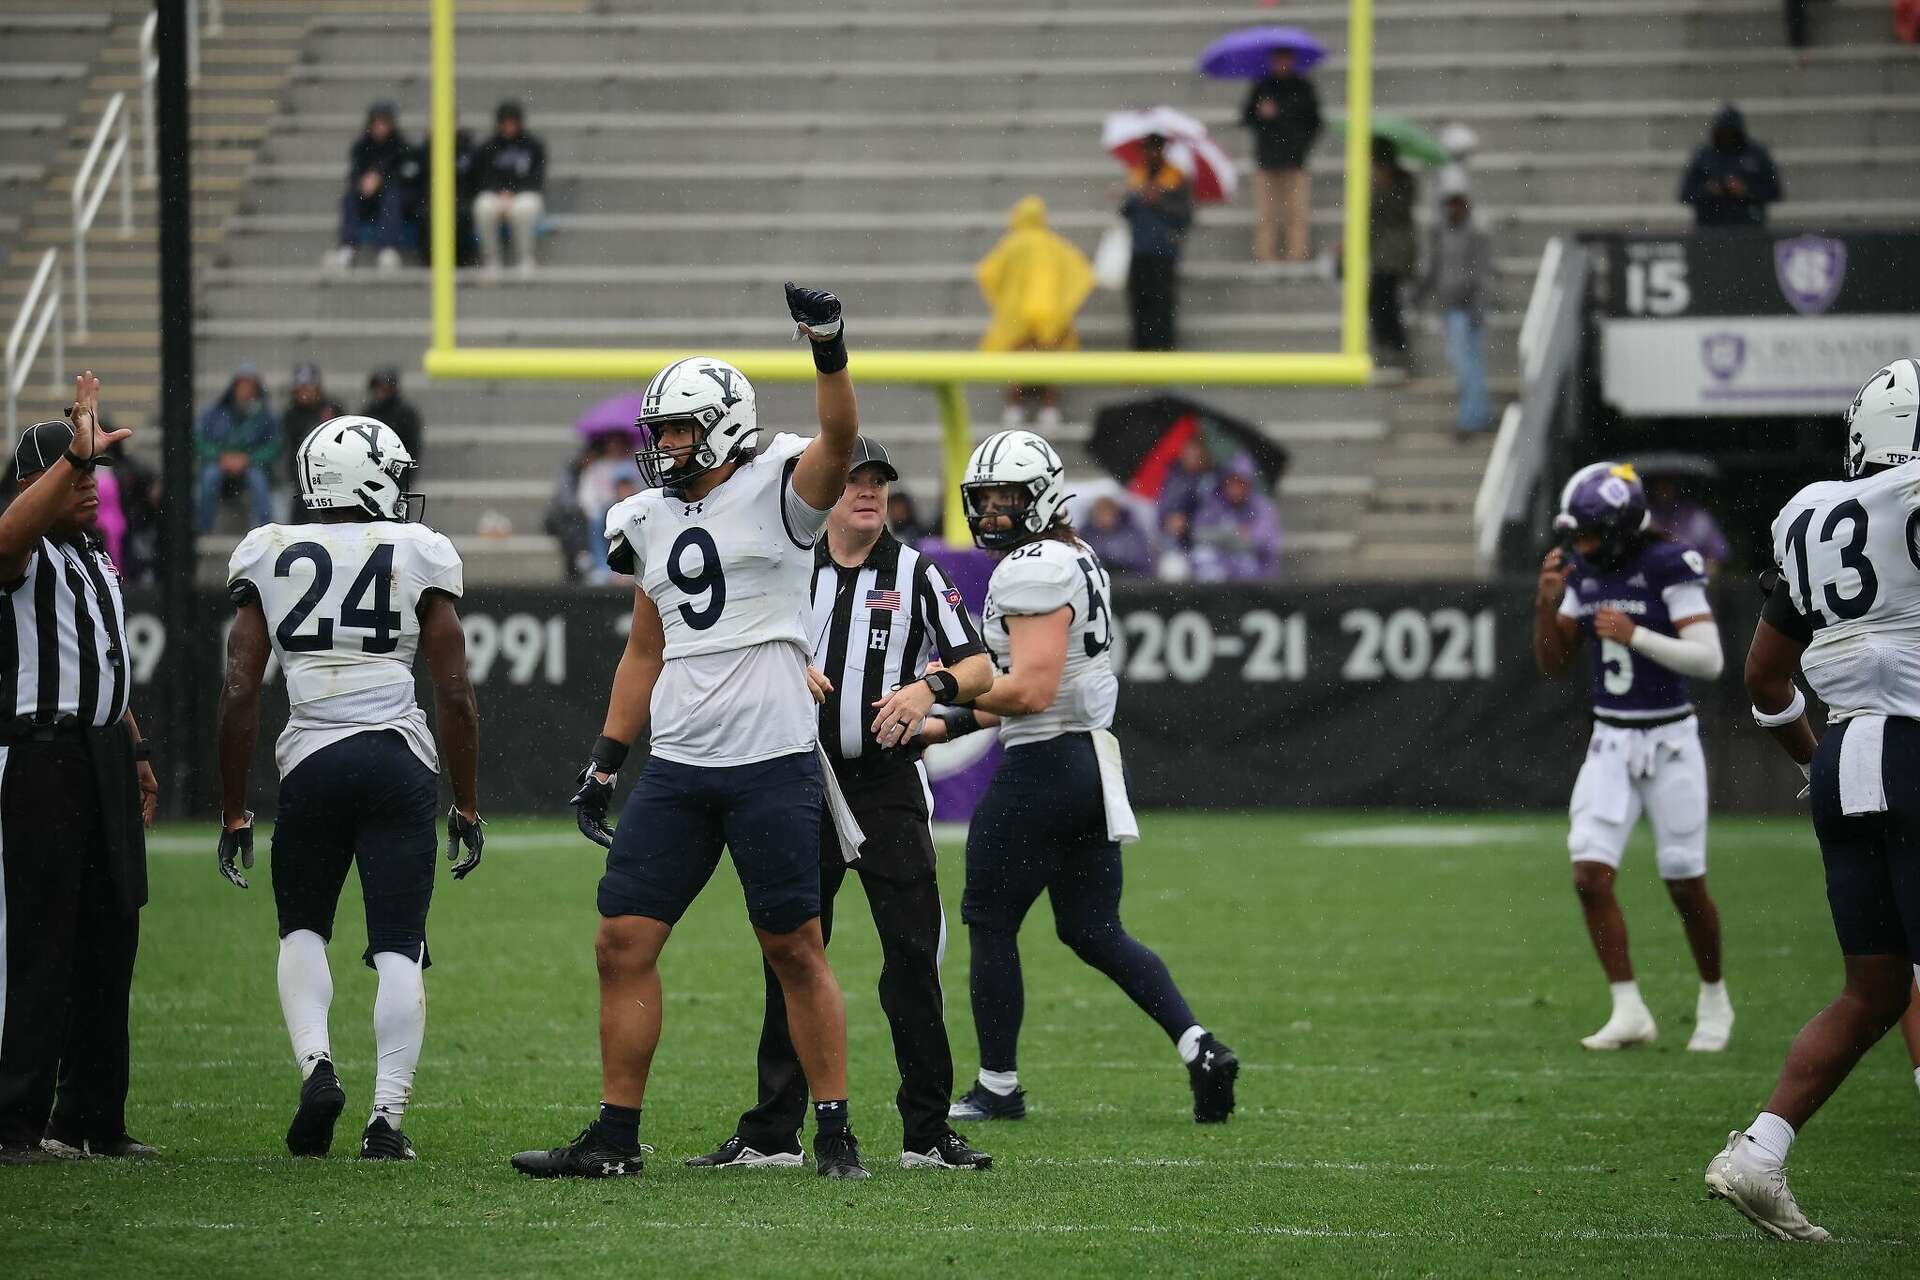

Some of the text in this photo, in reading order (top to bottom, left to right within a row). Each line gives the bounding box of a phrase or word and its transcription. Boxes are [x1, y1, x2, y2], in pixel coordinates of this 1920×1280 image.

[1626, 261, 1690, 315] 15
[699, 367, 742, 405] Y
[642, 406, 660, 416] YALE
[346, 424, 384, 459] Y
[1887, 453, 1920, 465] TE
[312, 476, 321, 485] 24
[973, 474, 994, 482] YALE
[315, 498, 334, 508] 151
[667, 527, 726, 630] 9
[1785, 498, 1879, 629] 13
[274, 541, 401, 654] 24
[1077, 554, 1114, 658] 5
[462, 612, 567, 686] 991
[869, 628, 889, 651] H
[1340, 608, 1495, 681] 2021
[1601, 639, 1634, 696] 5
